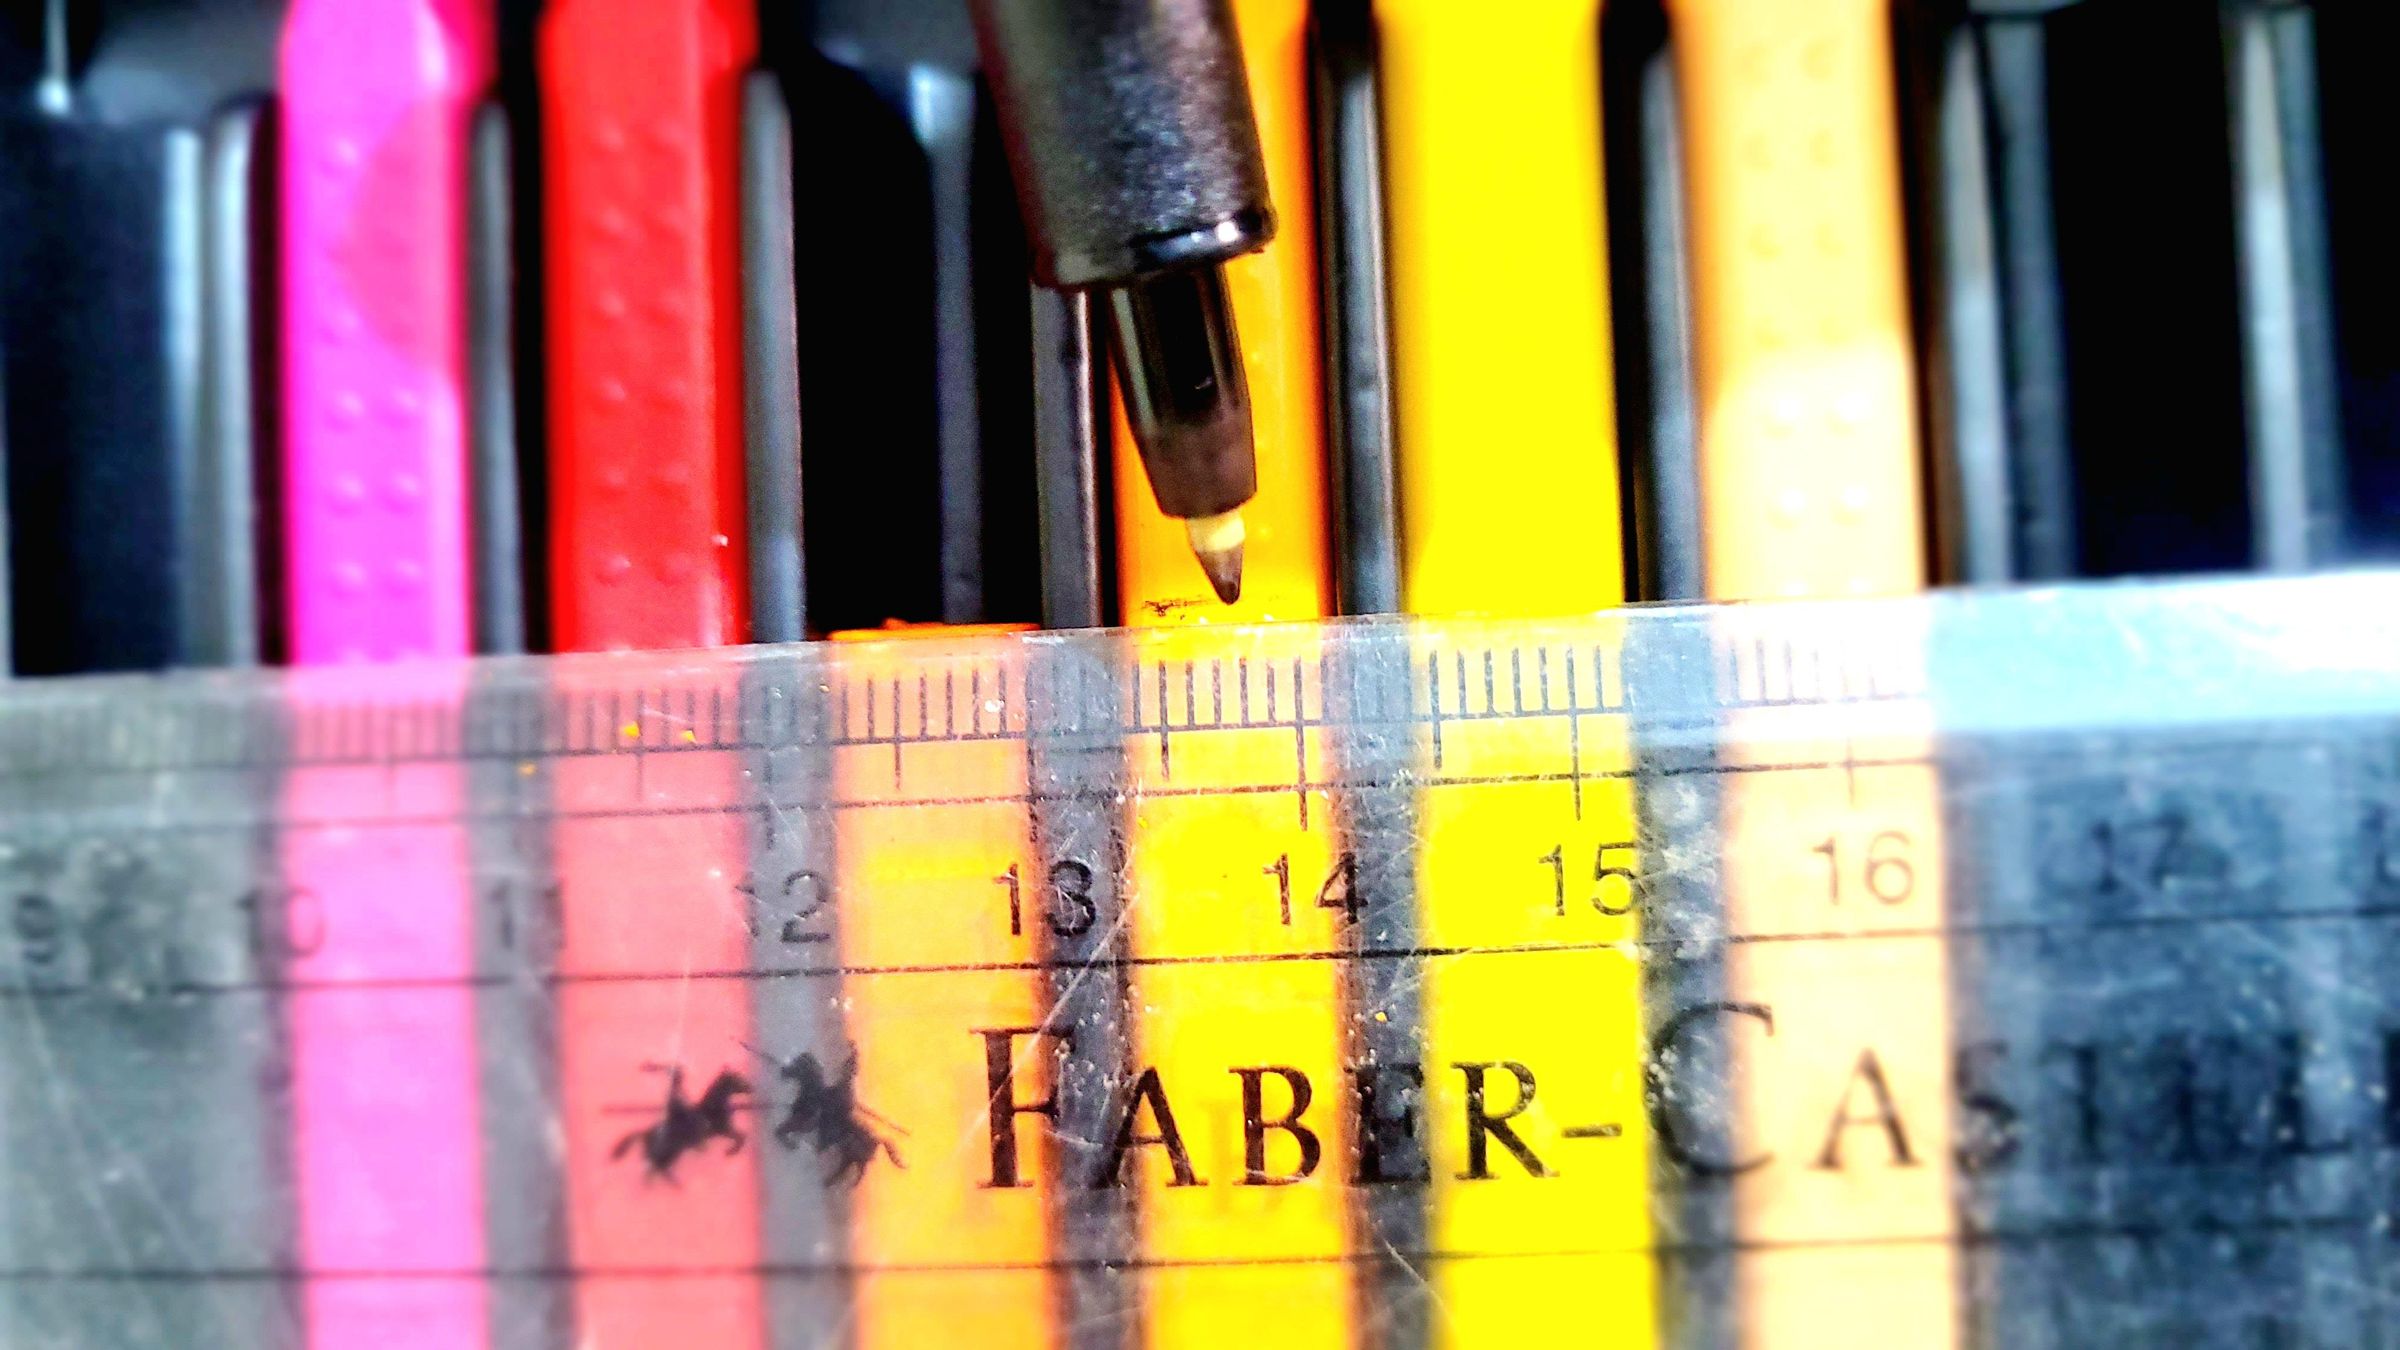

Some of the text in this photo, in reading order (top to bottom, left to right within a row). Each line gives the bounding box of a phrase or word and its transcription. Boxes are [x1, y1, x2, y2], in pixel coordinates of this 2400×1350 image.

[237, 886, 326, 958] 10
[735, 869, 831, 943] 12
[994, 860, 1097, 937] 13
[1264, 852, 1368, 926] 14
[1539, 841, 1642, 917] 15
[1813, 831, 1913, 906] 16
